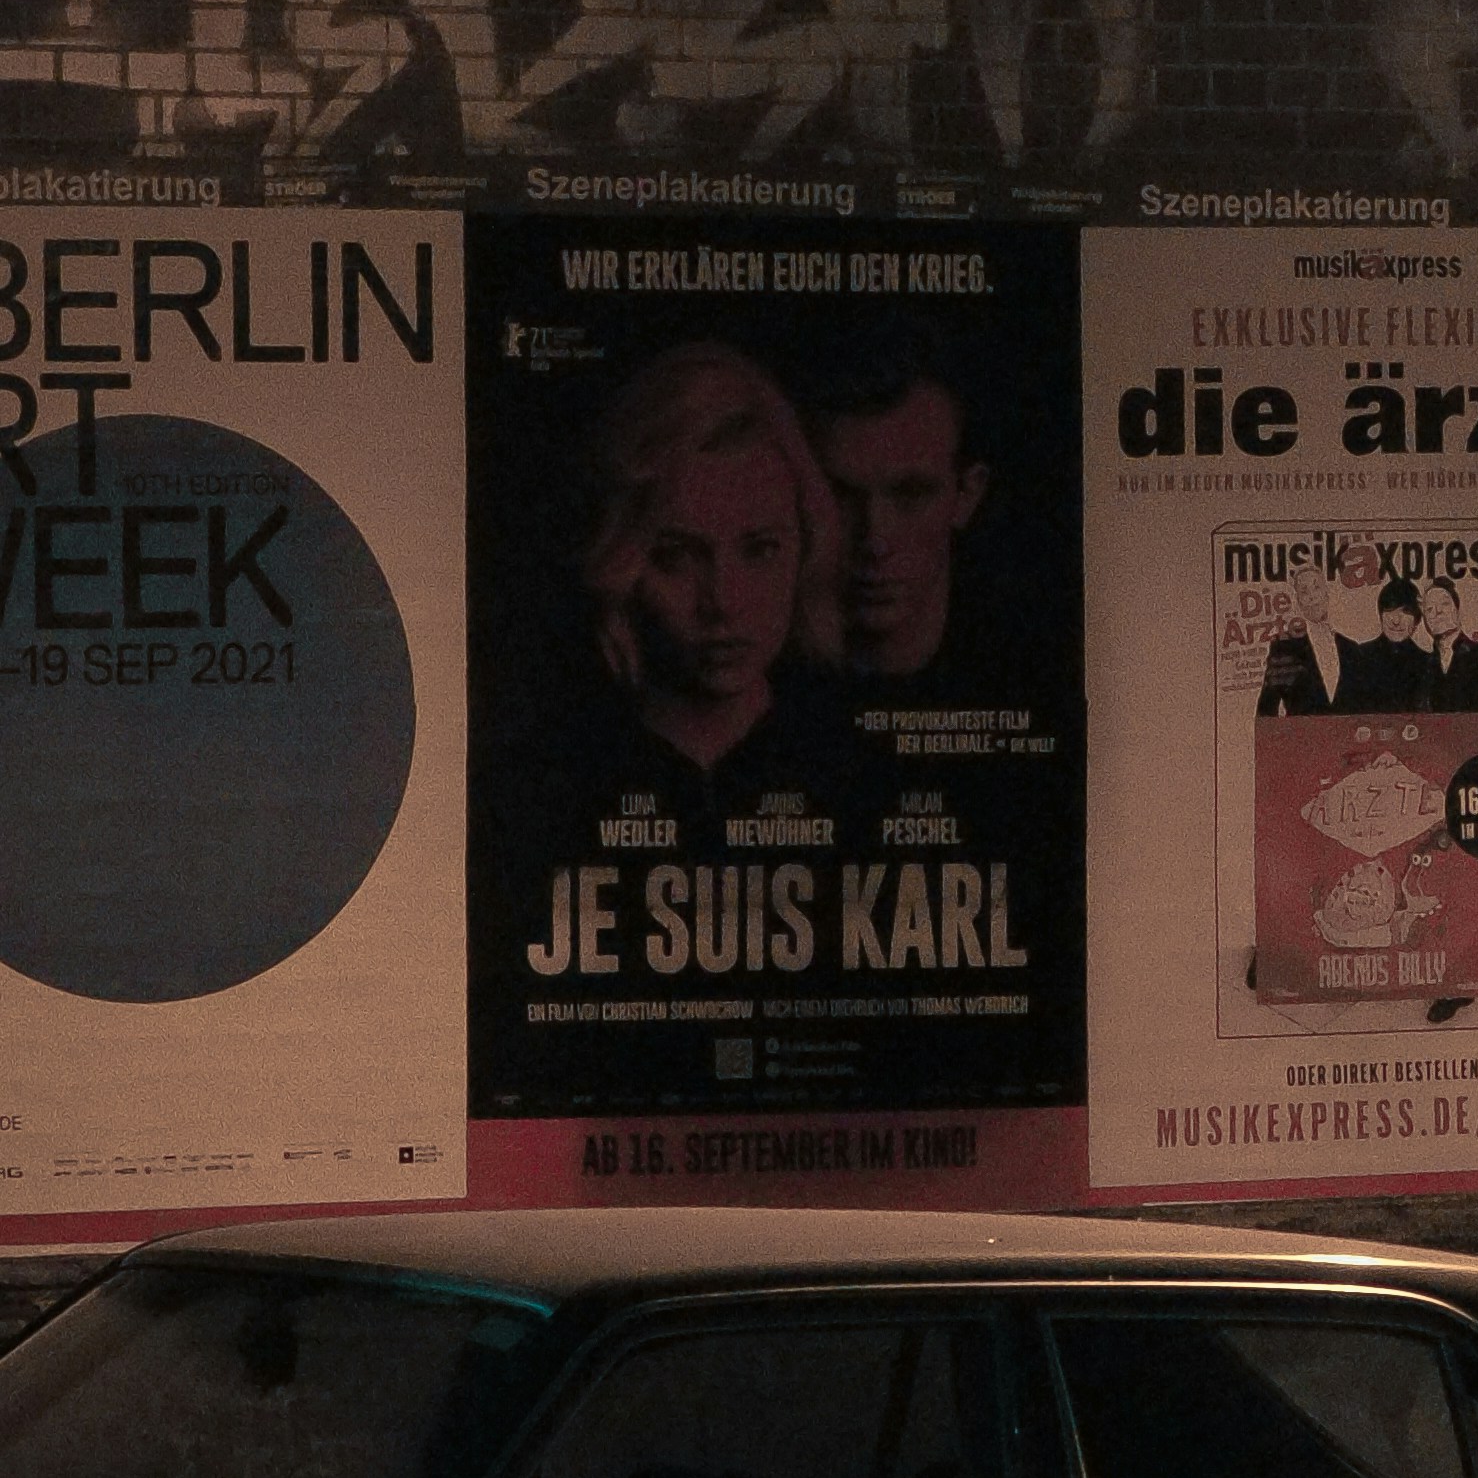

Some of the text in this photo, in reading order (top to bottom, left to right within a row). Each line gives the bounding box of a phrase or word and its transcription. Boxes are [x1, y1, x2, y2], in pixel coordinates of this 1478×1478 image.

[527, 167, 856, 214] Szeneplakatierung
[1140, 183, 1450, 226] Szeneplakatierung
[561, 245, 994, 293] WIR ERKLÄREN EUCH DEN KRIEG.
[1191, 307, 1371, 348] EXKLUSIVE
[1386, 307, 1476, 347] FLEXI
[1117, 367, 1299, 458] die
[188, 472, 290, 496] EDITION
[1117, 474, 1149, 493] NUR
[1157, 474, 1175, 492] IM
[1182, 474, 1234, 492] NEUEN
[1387, 471, 1418, 489] WER
[1426, 468, 1477, 490] HÖREN
[0, 505, 293, 629] EEK
[1239, 587, 1292, 619] Die
[1222, 611, 1307, 648] Ärzte
[84, 642, 179, 686] SEP
[191, 641, 297, 686] 2021
[892, 709, 998, 731] PROVOKANTESTE
[999, 710, 1032, 730] FILM
[896, 733, 921, 754] DER
[1027, 737, 1056, 754] WELT
[621, 793, 657, 816] LUNA
[901, 791, 943, 814] MILAN
[600, 819, 678, 848] WEDLER
[725, 814, 835, 847] NIEWÖHNER
[881, 817, 963, 845] PESCHEL
[1461, 822, 1475, 840] IM
[527, 860, 1030, 975] JE SUIS KARL
[1318, 951, 1447, 989] ABENDS BILLY
[527, 1002, 545, 1022] EIN
[548, 1002, 574, 1021] FILM
[576, 1002, 599, 1022] VON
[602, 1001, 668, 1021] CHRISTIAN
[911, 996, 961, 1016] THOMAS
[1287, 1065, 1327, 1087] ODER
[1332, 1063, 1388, 1085] DIREKT
[582, 1126, 978, 1176] AB 16. SEPTEMBER IM KINO!
